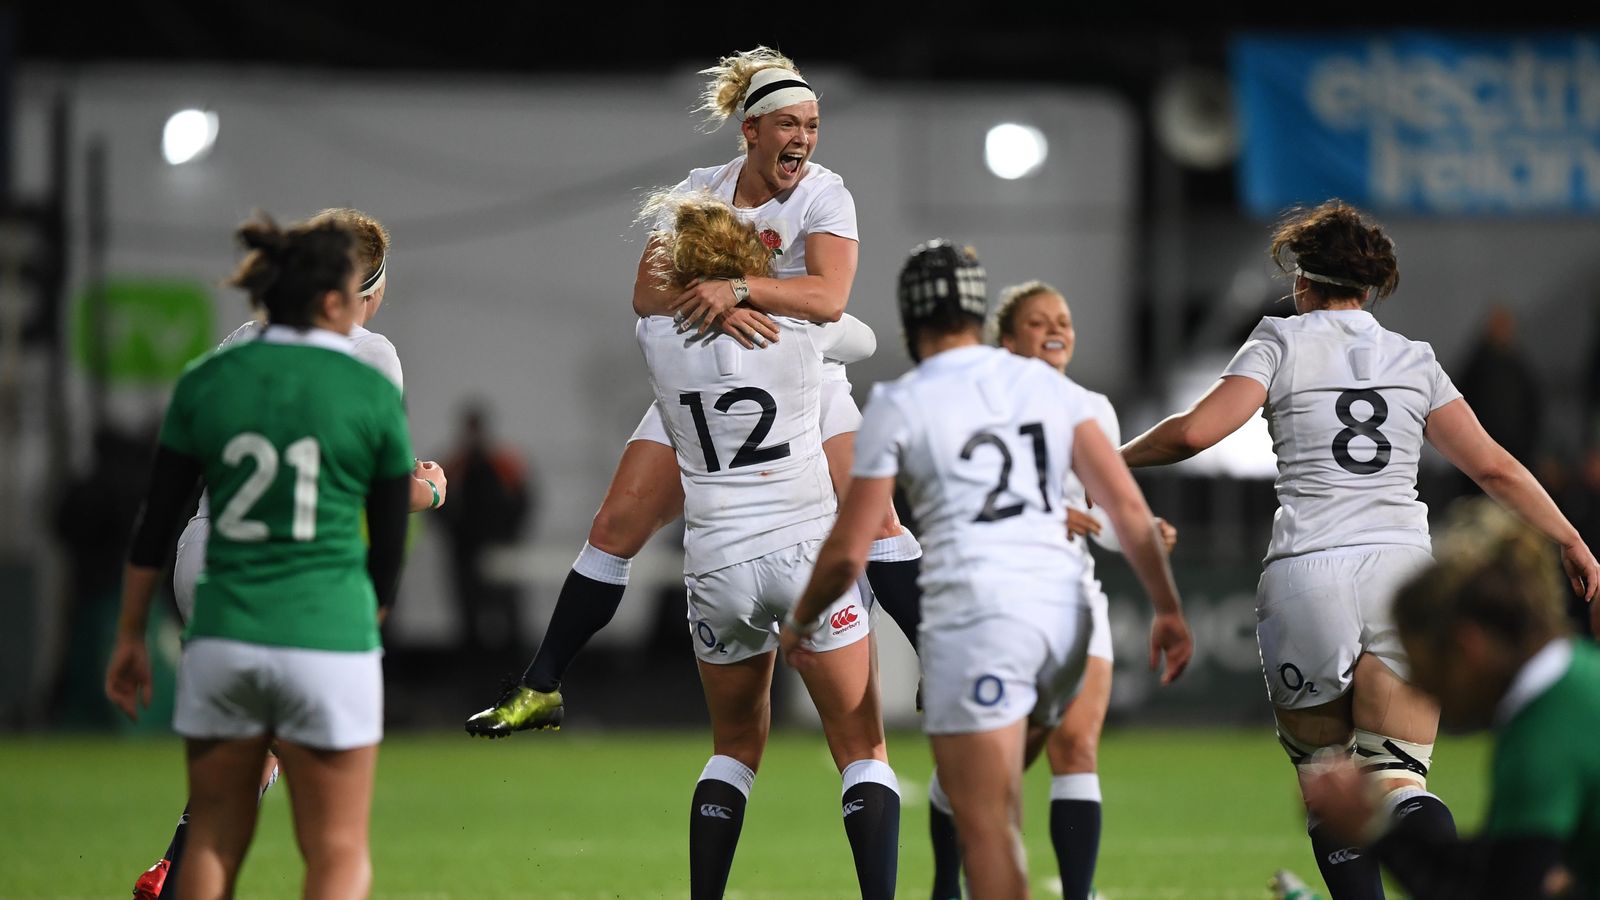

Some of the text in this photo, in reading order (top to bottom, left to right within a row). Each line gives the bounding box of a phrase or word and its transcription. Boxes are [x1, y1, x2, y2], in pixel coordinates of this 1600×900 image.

[679, 386, 791, 473] 12
[959, 422, 1052, 523] 21
[1331, 388, 1392, 475] 8
[216, 432, 320, 542] 21
[1280, 662, 1318, 693] O2
